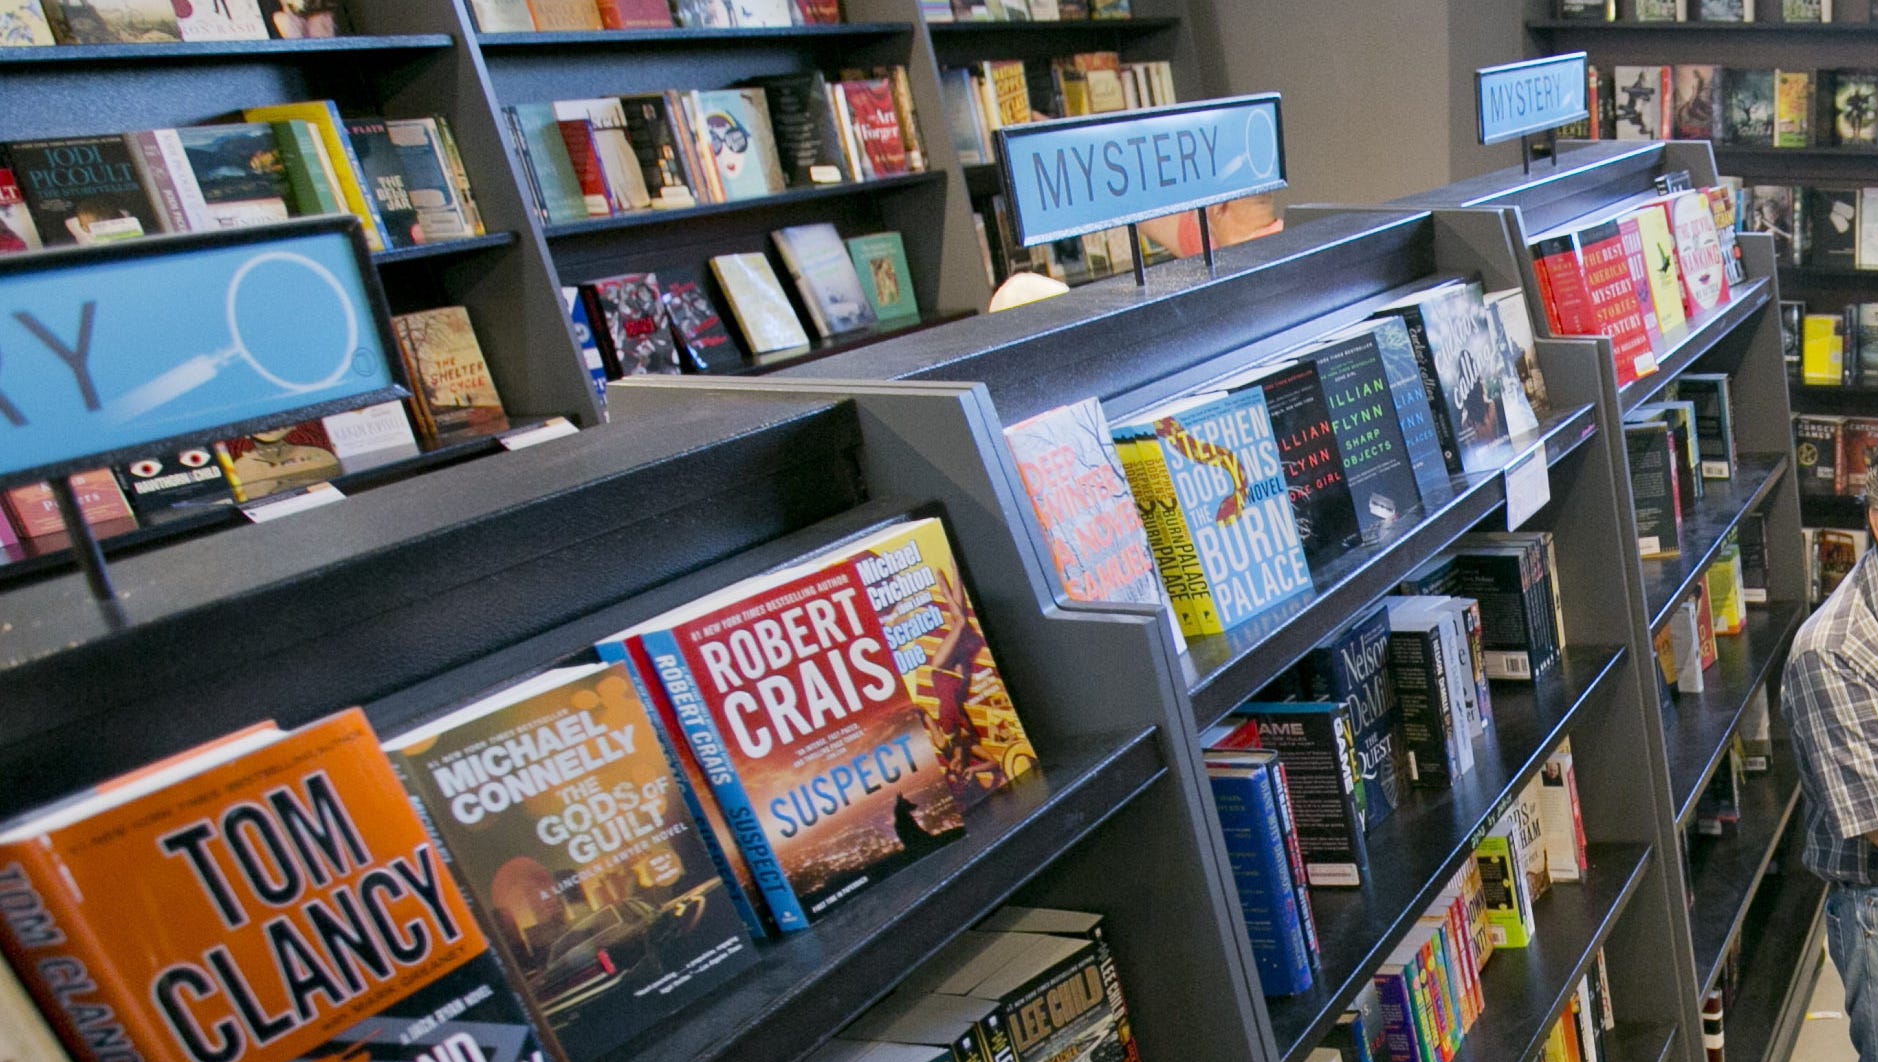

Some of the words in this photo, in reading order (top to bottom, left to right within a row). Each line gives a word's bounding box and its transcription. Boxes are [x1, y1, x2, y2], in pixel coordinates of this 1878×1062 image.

[1488, 71, 1562, 122] MYSTERY
[29, 163, 134, 189] PICOULT
[43, 147, 103, 167] JODI
[1031, 125, 1221, 211] MYSTERY
[376, 175, 404, 189] THE
[1584, 252, 1602, 266] THE
[1602, 244, 1623, 261] BEST
[1586, 263, 1629, 285] AMERICAN
[1681, 246, 1722, 271] NANKING
[1590, 281, 1633, 304] MYSTERY
[1596, 298, 1638, 320] STORIES
[429, 358, 487, 388] SHELTER
[435, 356, 457, 370] THE
[448, 373, 488, 395] CYCLE
[1166, 399, 1271, 470] STEPHEN
[1330, 402, 1385, 433] FLYNN
[1343, 425, 1382, 454] SHARP
[1023, 446, 1078, 492] DEEP
[1176, 439, 1280, 510] DOBYNS
[1341, 437, 1393, 469] OBJECTS
[1036, 465, 1127, 521] WINTER
[1246, 474, 1284, 505] NOVEL
[1314, 470, 1342, 491] GIRL
[1074, 507, 1144, 552] NOVEL
[1191, 501, 1213, 528] THE
[855, 539, 923, 586] Michael
[1200, 507, 1299, 583] BURN
[868, 567, 936, 612] Crichton
[1065, 549, 1154, 603] SAMUEL
[1215, 545, 1309, 624] PALACE
[703, 621, 721, 635] NEW
[719, 614, 742, 632] YORK
[741, 604, 767, 624] TIMES
[764, 582, 818, 614] BESTSELLING
[816, 574, 850, 594] AUTHOR
[699, 589, 868, 695] ROBERT
[883, 609, 944, 649] Scratch
[893, 648, 928, 675] One
[723, 636, 897, 760] CRAIS
[653, 654, 704, 738] ROBERT
[690, 730, 732, 788] CRAIS
[1364, 730, 1379, 750] THE
[434, 710, 608, 798] MICHAEL
[450, 725, 638, 826] CONNELLY
[1333, 715, 1355, 796] GAME
[557, 776, 599, 804] THE
[769, 735, 919, 839] SUSPECT
[535, 781, 643, 846] GODS
[640, 776, 670, 802] OF
[567, 802, 667, 864] GUILT
[162, 771, 373, 929] TOM
[650, 822, 689, 850] NOVEL
[729, 804, 786, 892] SUSPECT
[1009, 1008, 1049, 1052] LEE
[1045, 970, 1104, 1029] CHILD
